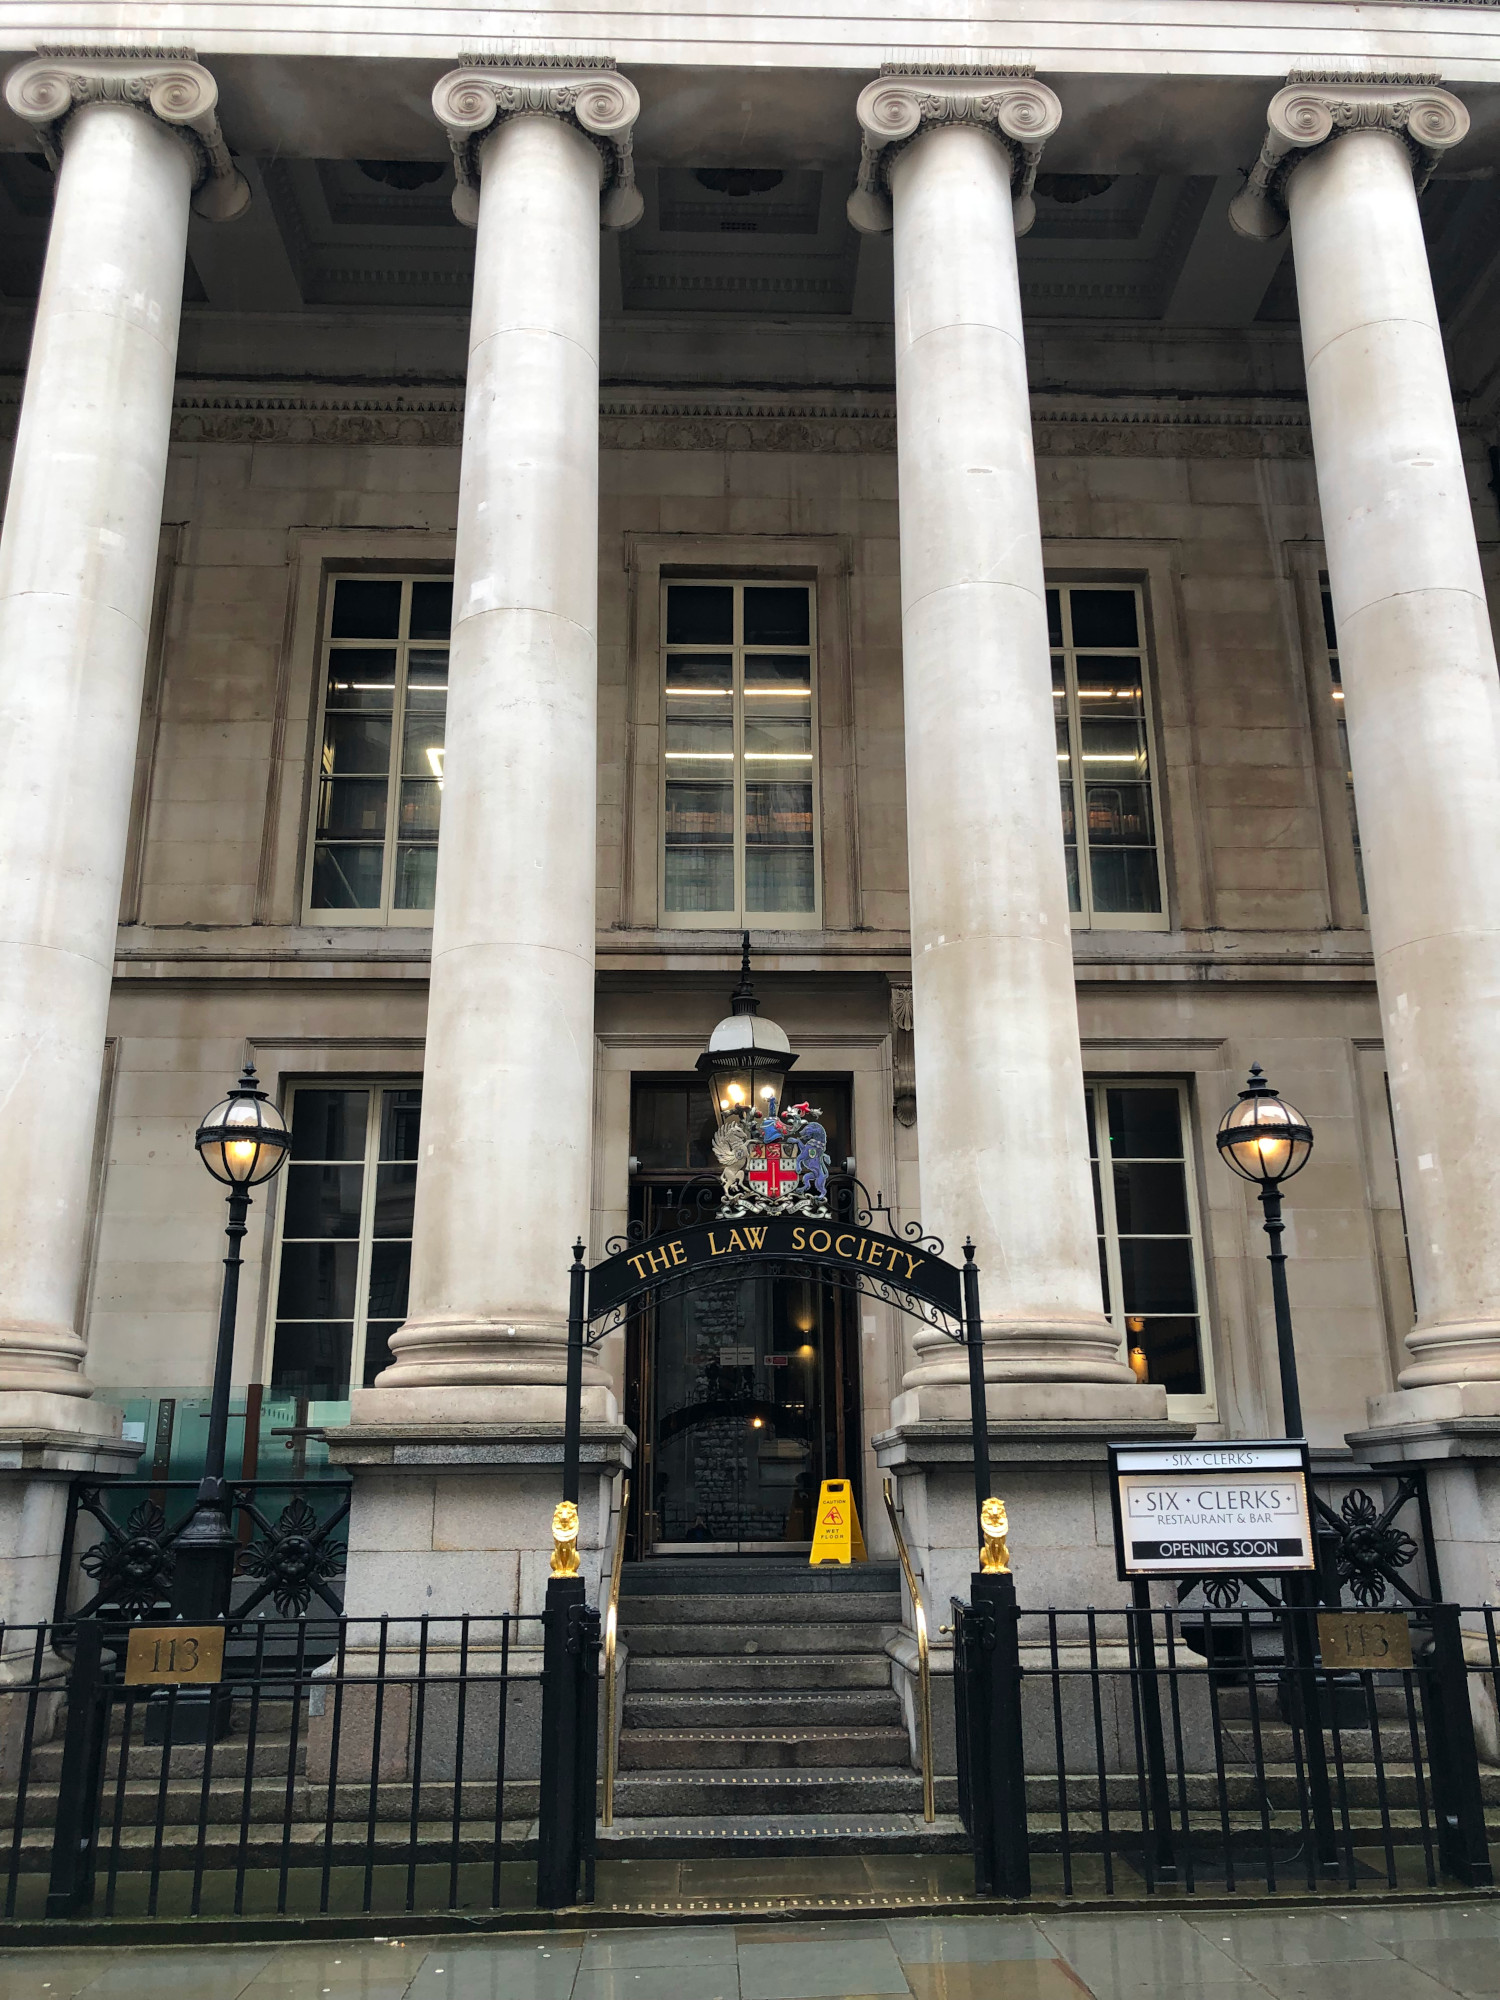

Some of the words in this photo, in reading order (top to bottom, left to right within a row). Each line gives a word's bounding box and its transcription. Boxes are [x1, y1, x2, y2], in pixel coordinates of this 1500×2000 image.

[626, 1240, 688, 1280] THE
[707, 1226, 769, 1256] LAW
[791, 1227, 926, 1280] SOCIETY
[1172, 1454, 1193, 1466] SIX
[1202, 1452, 1253, 1466] CLERKS
[1146, 1491, 1180, 1511] SIX
[1197, 1489, 1281, 1510] CLERKS
[1157, 1513, 1233, 1525] RESTAURANT
[1236, 1513, 1247, 1524] &
[1249, 1512, 1273, 1524] BAR
[1159, 1541, 1229, 1557] OPENING
[1232, 1540, 1278, 1555] SOON
[1343, 1624, 1389, 1657] 113
[149, 1637, 199, 1673] 113
